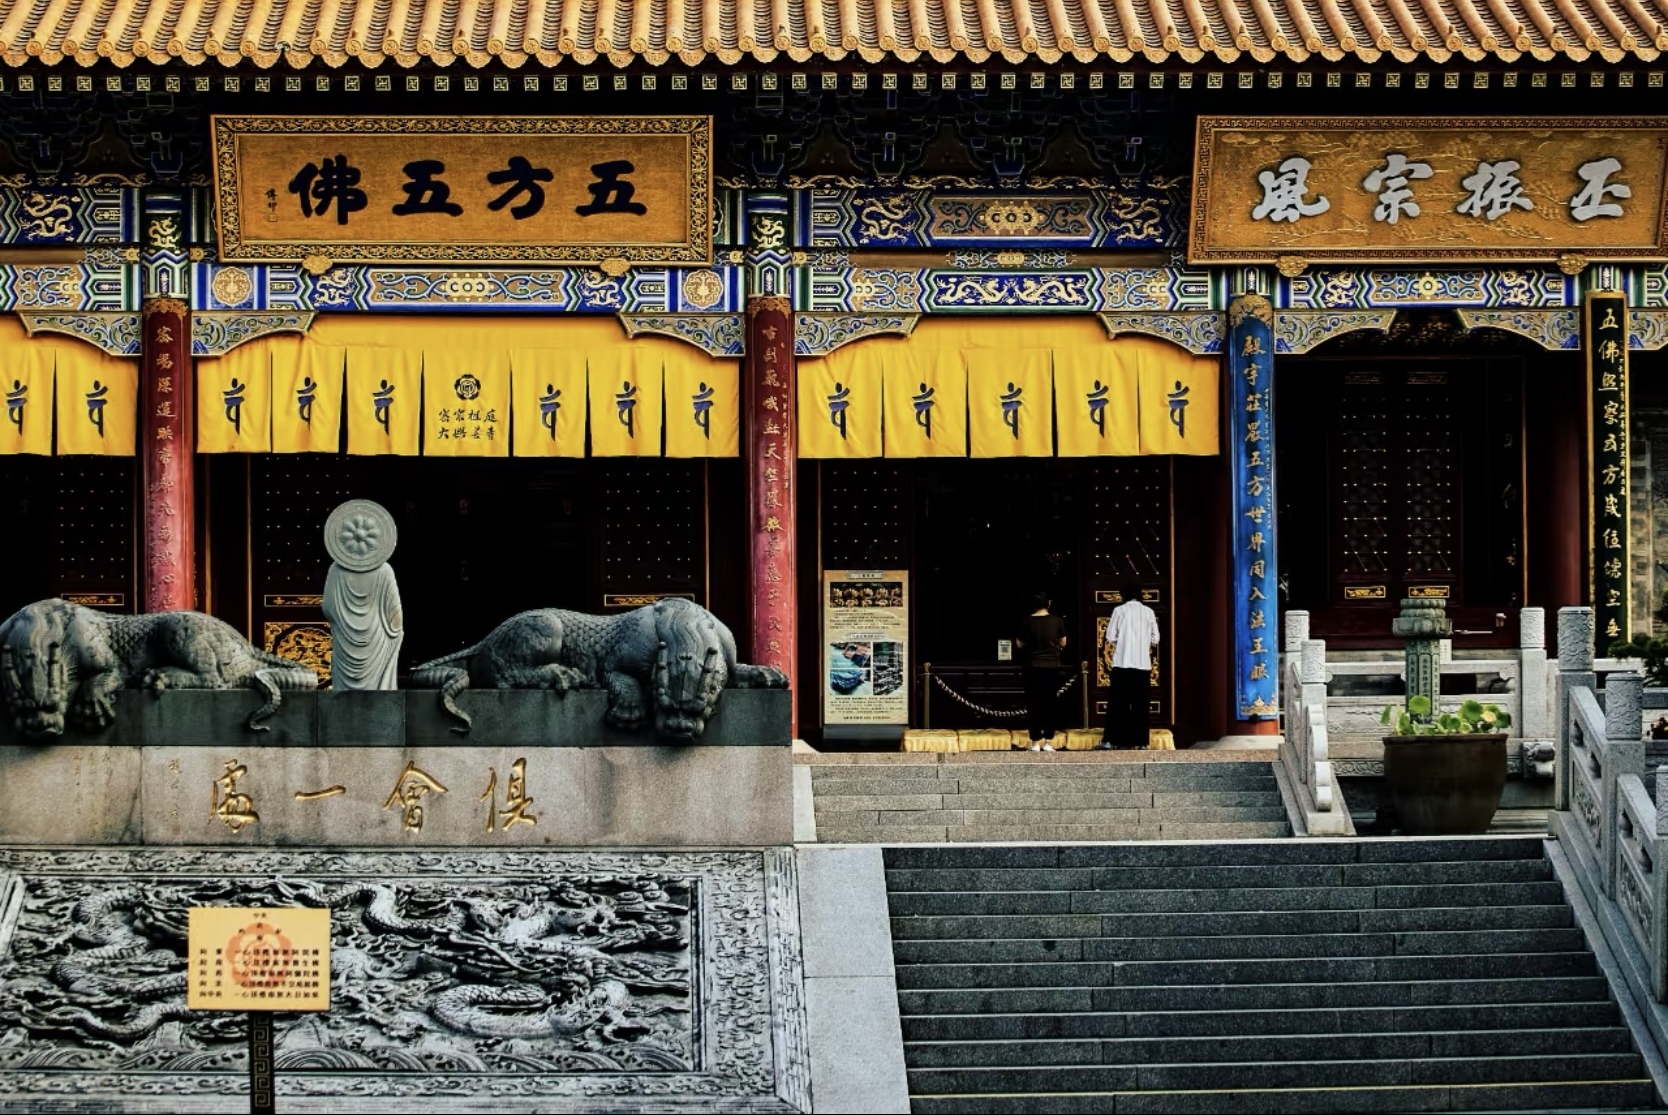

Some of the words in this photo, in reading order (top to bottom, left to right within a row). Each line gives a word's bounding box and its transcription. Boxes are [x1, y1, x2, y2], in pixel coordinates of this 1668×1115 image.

[288, 154, 648, 226] 五方五佛
[438, 407, 498, 423] 密宗祖庭
